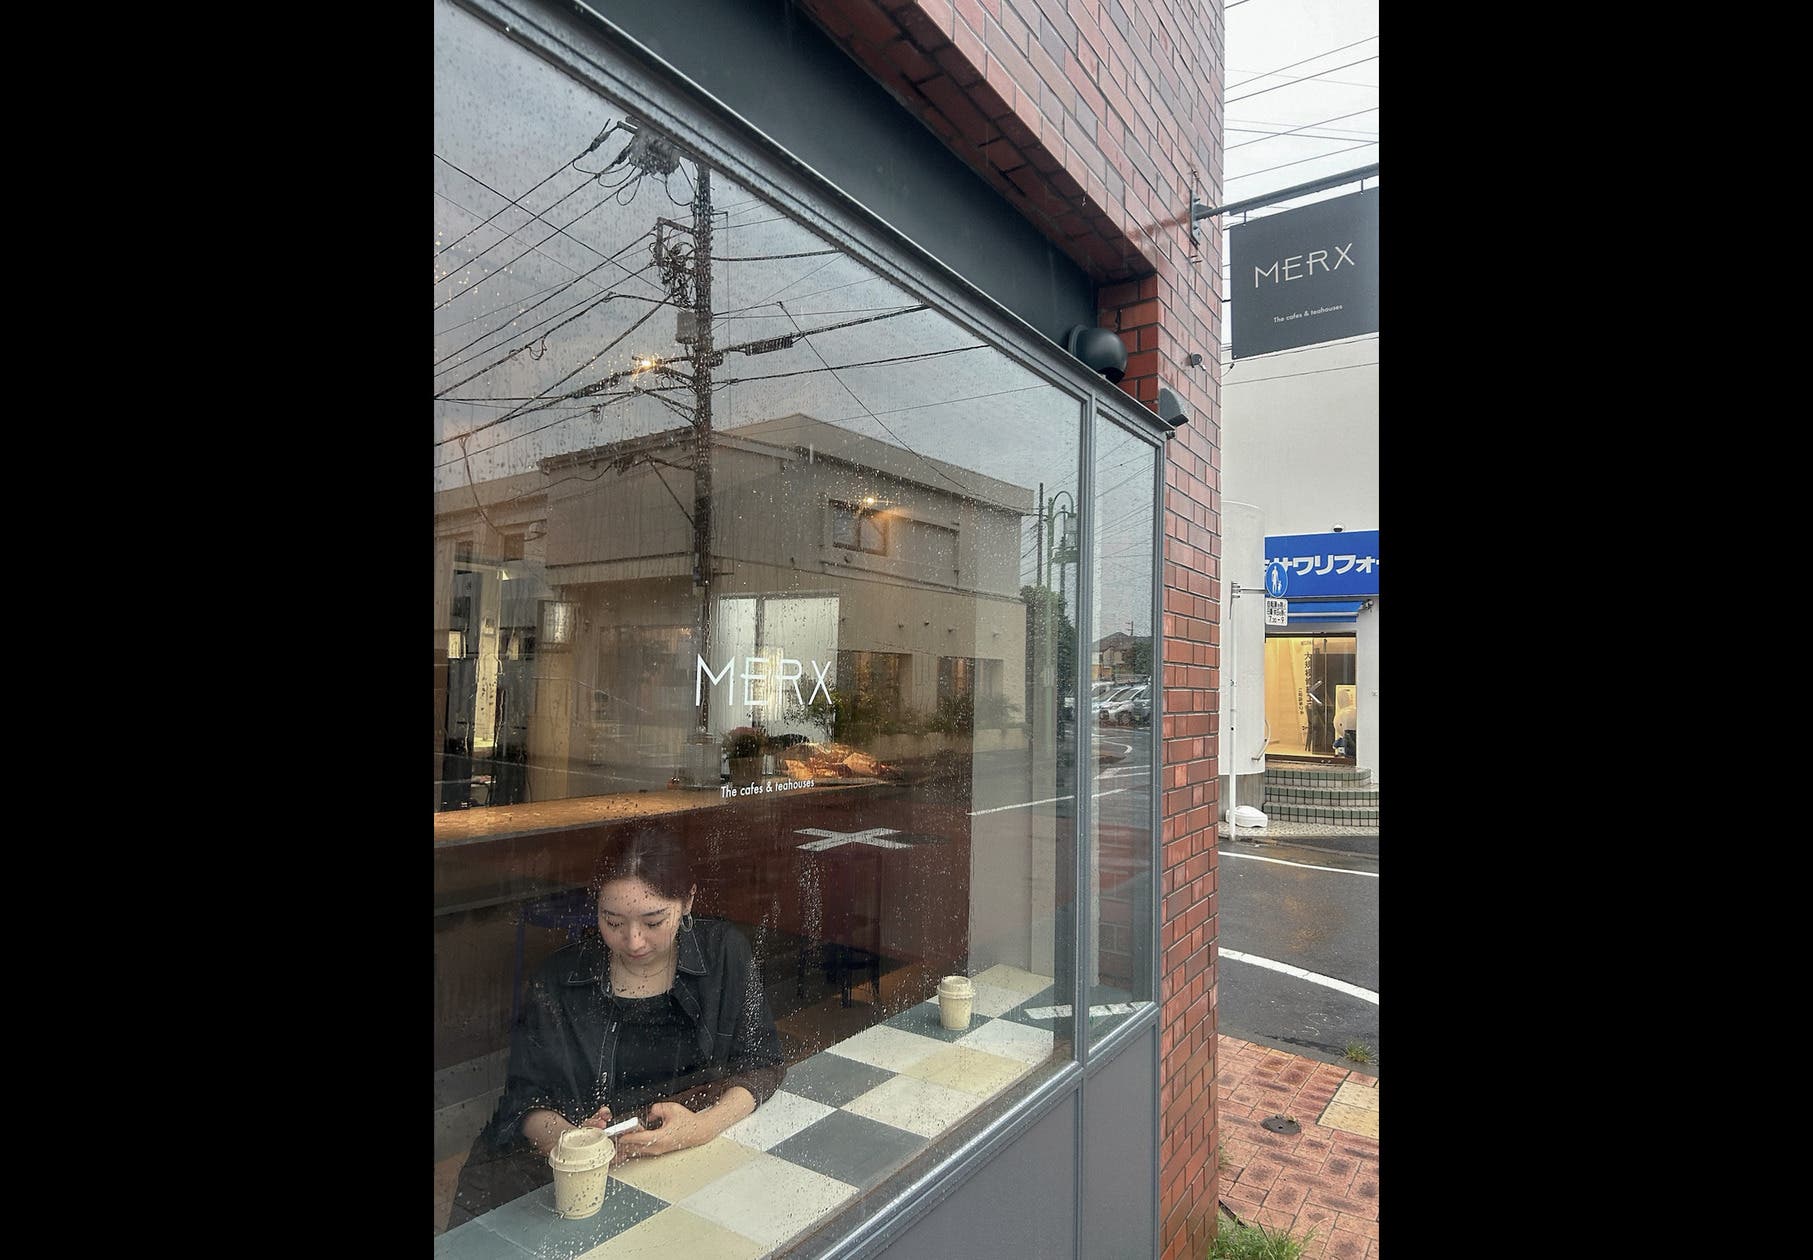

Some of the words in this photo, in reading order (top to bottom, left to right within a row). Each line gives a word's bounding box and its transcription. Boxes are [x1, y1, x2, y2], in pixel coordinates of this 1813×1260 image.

[1255, 242, 1355, 289] MERX
[1273, 316, 1285, 324] The
[1286, 312, 1302, 321] cafes
[1310, 304, 1343, 316] teahouses
[1265, 554, 1379, 576] サワリフォ
[695, 653, 833, 707] MERX
[720, 785, 738, 798] The
[740, 782, 763, 796] cafes
[765, 782, 773, 793] &
[775, 778, 815, 792] teahouses
